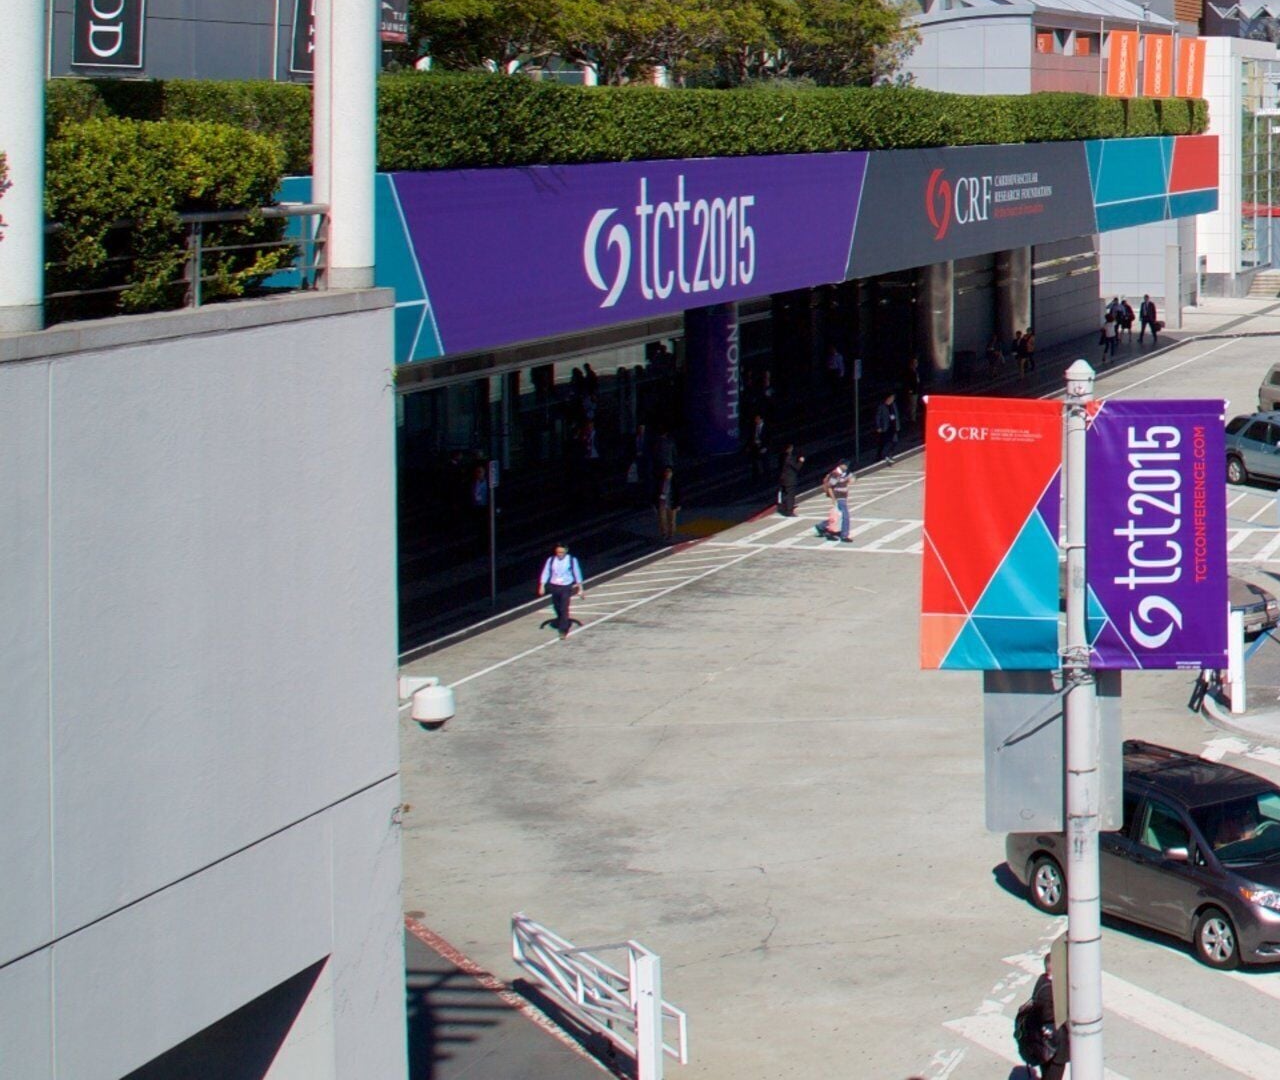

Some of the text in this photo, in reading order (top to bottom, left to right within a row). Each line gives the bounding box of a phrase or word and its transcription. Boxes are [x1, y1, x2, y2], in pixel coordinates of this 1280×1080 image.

[636, 175, 756, 300] tct2015
[954, 176, 992, 224] CRF
[958, 427, 989, 441] CRF
[1113, 426, 1182, 590] tct2015
[1193, 425, 1207, 584] TCTCONFERENCE.COM
